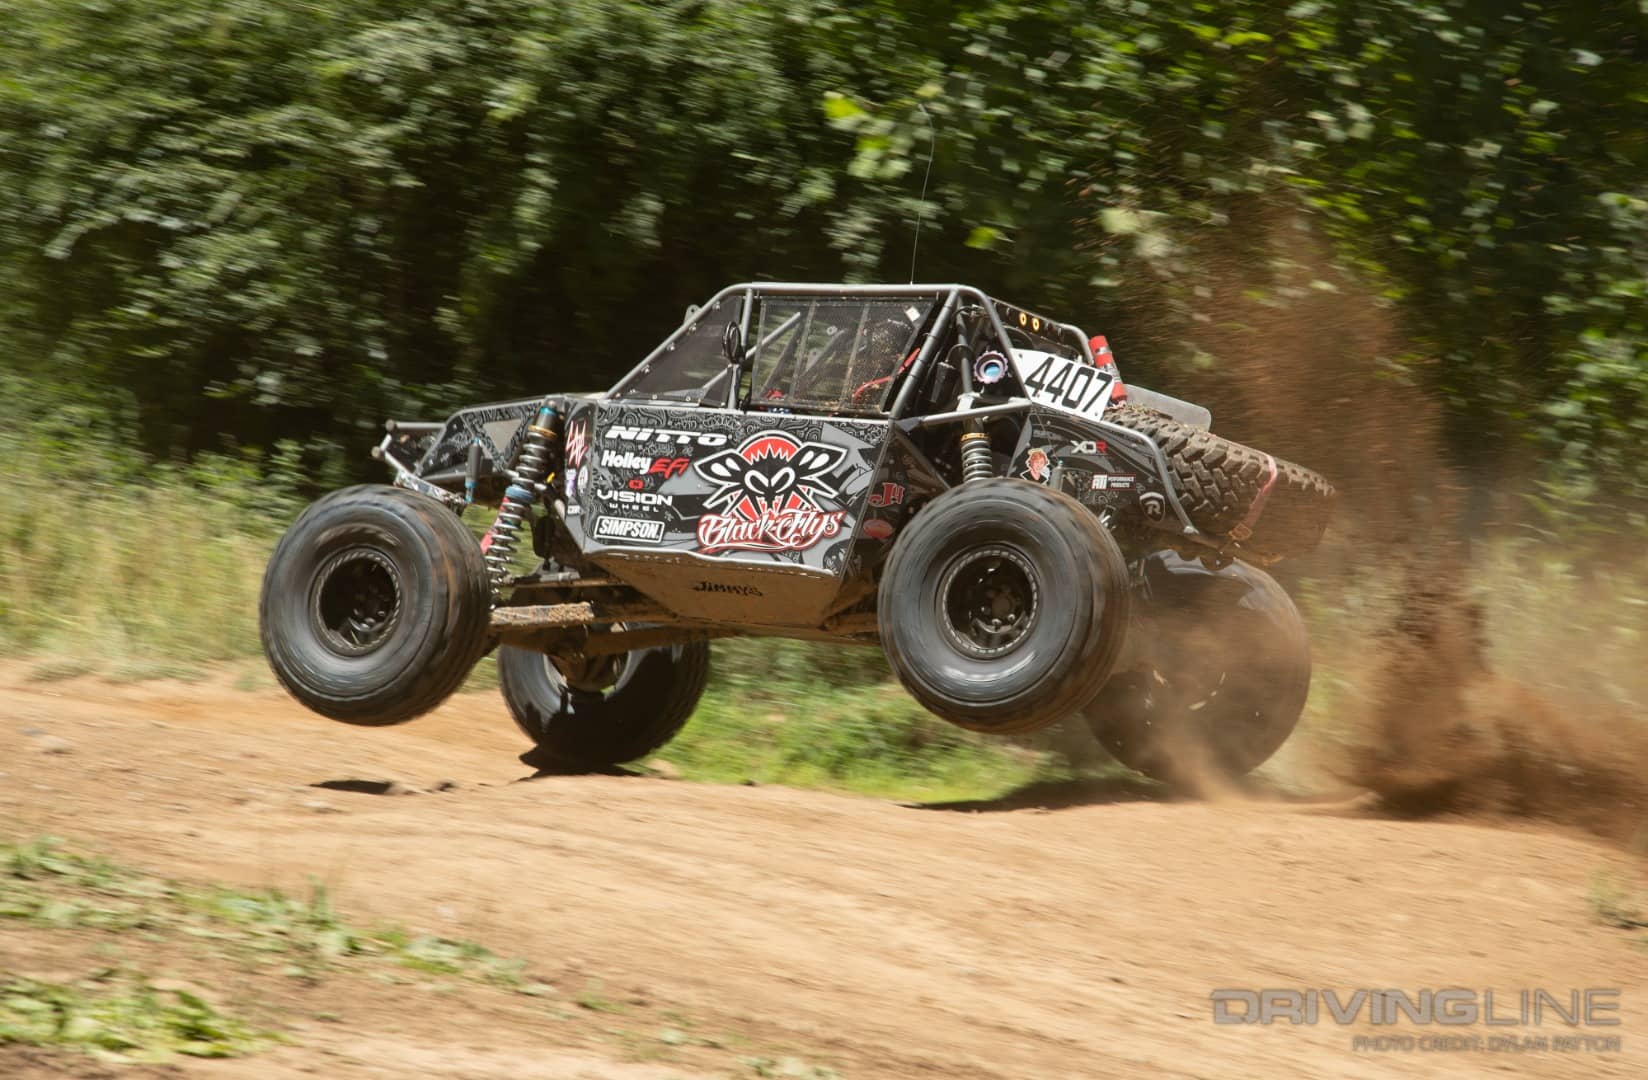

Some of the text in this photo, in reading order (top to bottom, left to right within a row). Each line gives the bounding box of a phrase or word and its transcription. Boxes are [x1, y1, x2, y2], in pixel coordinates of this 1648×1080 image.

[1024, 356, 1113, 412] 4407
[605, 425, 727, 446] NITTO
[601, 450, 690, 479] Holley EFI
[596, 489, 673, 506] VISION
[609, 502, 659, 513] WHEEL
